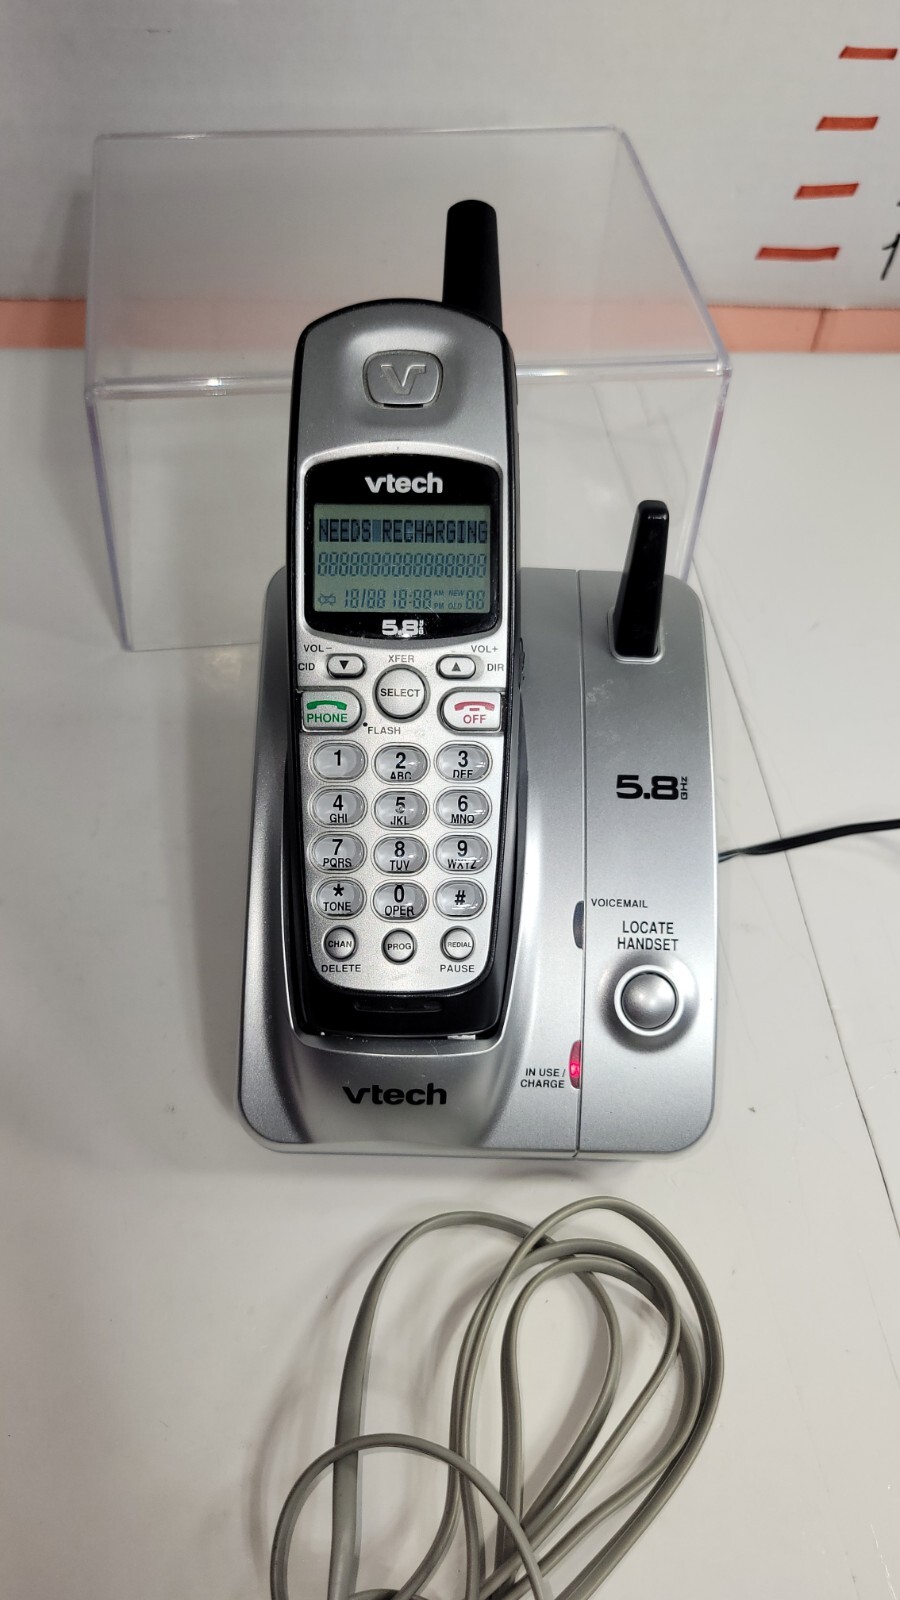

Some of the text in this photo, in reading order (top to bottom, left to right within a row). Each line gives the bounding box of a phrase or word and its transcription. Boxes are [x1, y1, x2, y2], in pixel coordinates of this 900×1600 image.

[364, 472, 443, 494] vtech
[318, 518, 488, 544] NEEDS RECHARGING
[433, 588, 445, 598] AM
[448, 589, 465, 598] NEW
[433, 602, 463, 611] PM OLD
[388, 654, 415, 663] XFER
[298, 662, 315, 671] CID
[487, 663, 505, 672] DIR
[380, 688, 421, 698] SELECT
[306, 713, 348, 724] PHONE
[463, 714, 487, 725] OFF
[367, 726, 401, 735] FLASH
[333, 750, 342, 766] 1
[395, 752, 406, 770] 2
[457, 750, 469, 768] 3
[390, 771, 412, 780] ABC
[616, 775, 679, 800] 5.8
[332, 794, 344, 811] 4
[395, 797, 406, 814] 5
[457, 795, 468, 812] 6
[329, 813, 348, 823] GHI
[390, 815, 410, 826] JKL
[332, 839, 343, 856] 7
[394, 841, 405, 858] 8
[457, 840, 468, 857] 9
[322, 857, 352, 868] PQRS
[389, 860, 410, 871] TUV
[454, 890, 466, 906] #
[591, 898, 648, 908] VOICEMAIL
[323, 901, 352, 912] TONE
[384, 906, 414, 917] OPER
[622, 921, 674, 935] LOCATE
[328, 940, 352, 948] CHAN
[387, 942, 412, 951] PROG
[617, 937, 679, 951] HANDSET
[321, 965, 361, 973] DELETE
[440, 965, 475, 973] PAUSE
[525, 1068, 536, 1077] IN
[520, 1079, 564, 1089] CHARGE
[342, 1083, 447, 1105] vtech
